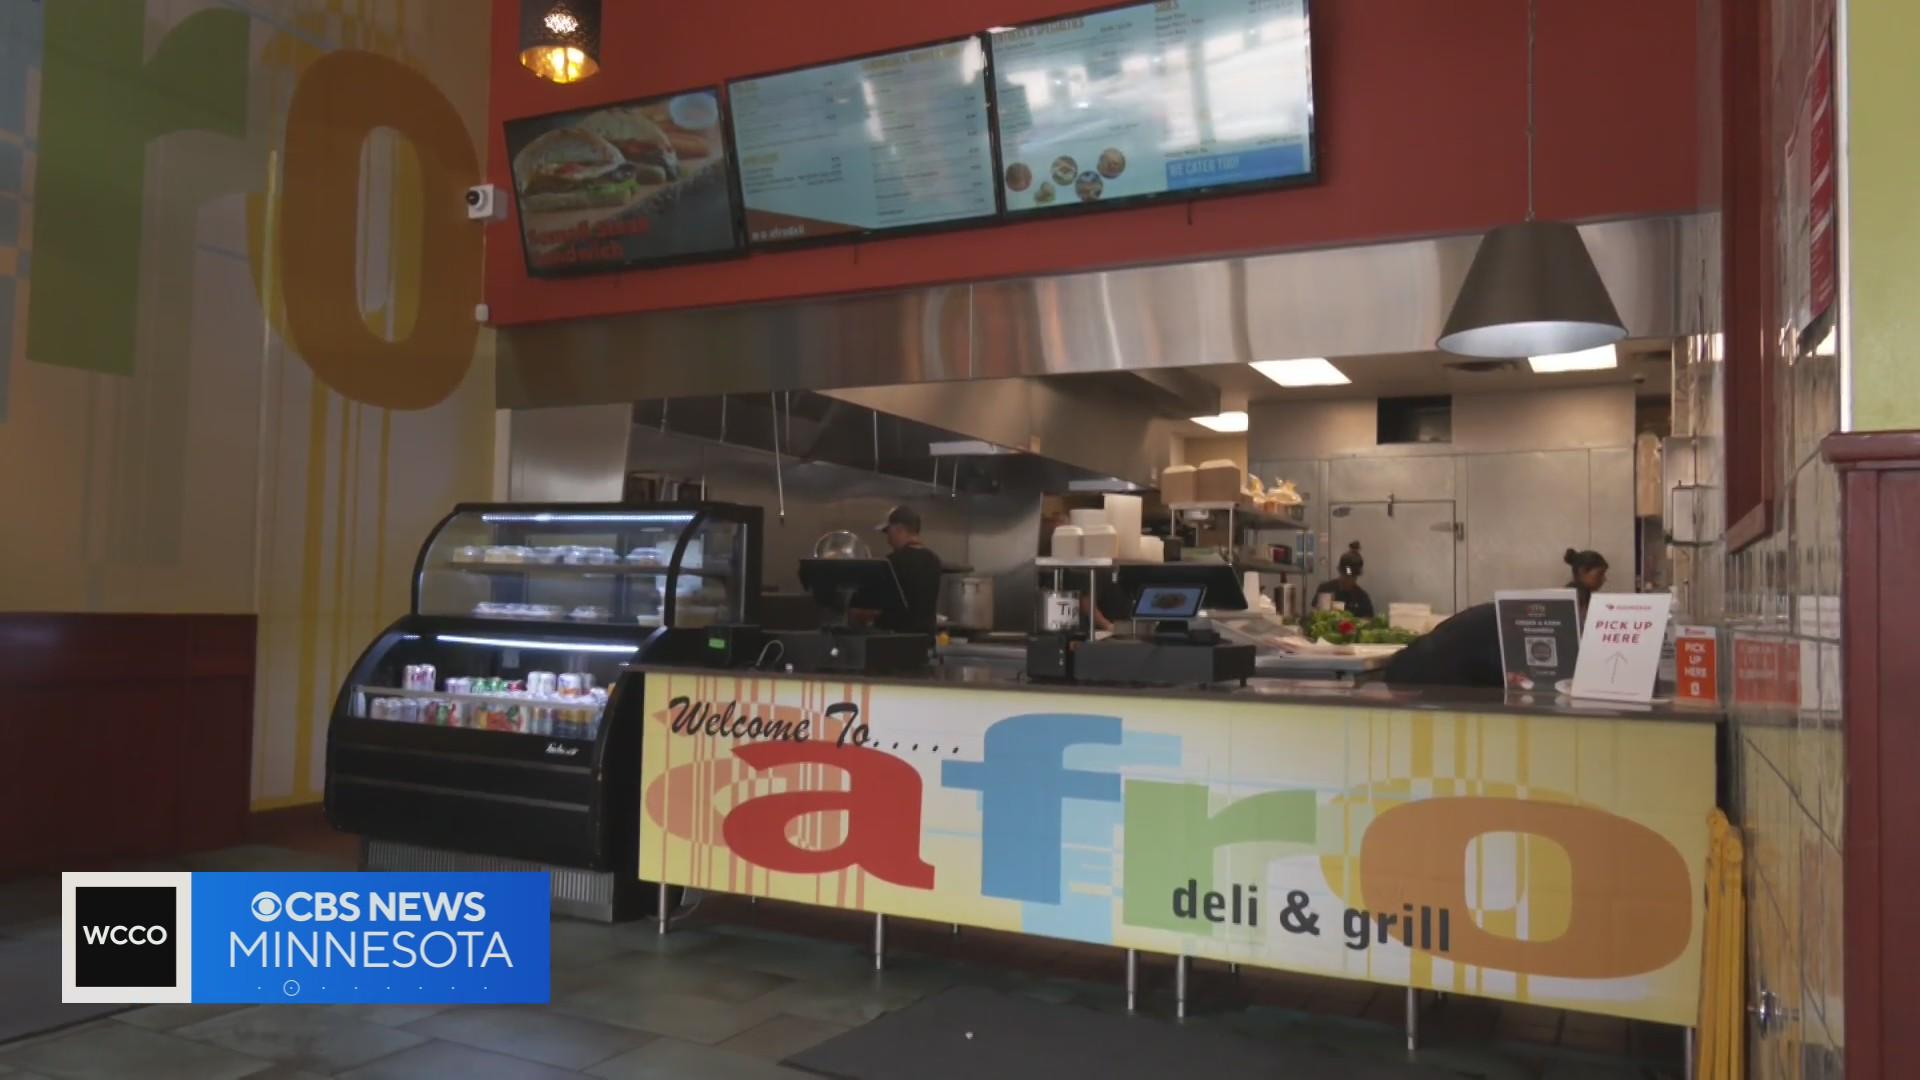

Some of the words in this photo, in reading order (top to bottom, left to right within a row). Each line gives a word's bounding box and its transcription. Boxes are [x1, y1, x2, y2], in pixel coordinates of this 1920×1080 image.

[1595, 620, 1629, 631] PICK
[1633, 620, 1653, 631] UP
[1601, 633, 1641, 644] HERE
[1684, 641, 1706, 653] PICK
[1688, 654, 1703, 666] UP
[1683, 666, 1707, 679] HERE
[669, 696, 810, 742] Welcome
[722, 713, 1692, 980] afro
[1172, 879, 1258, 927] deli
[1279, 890, 1320, 936] &
[1343, 904, 1449, 952] grill
